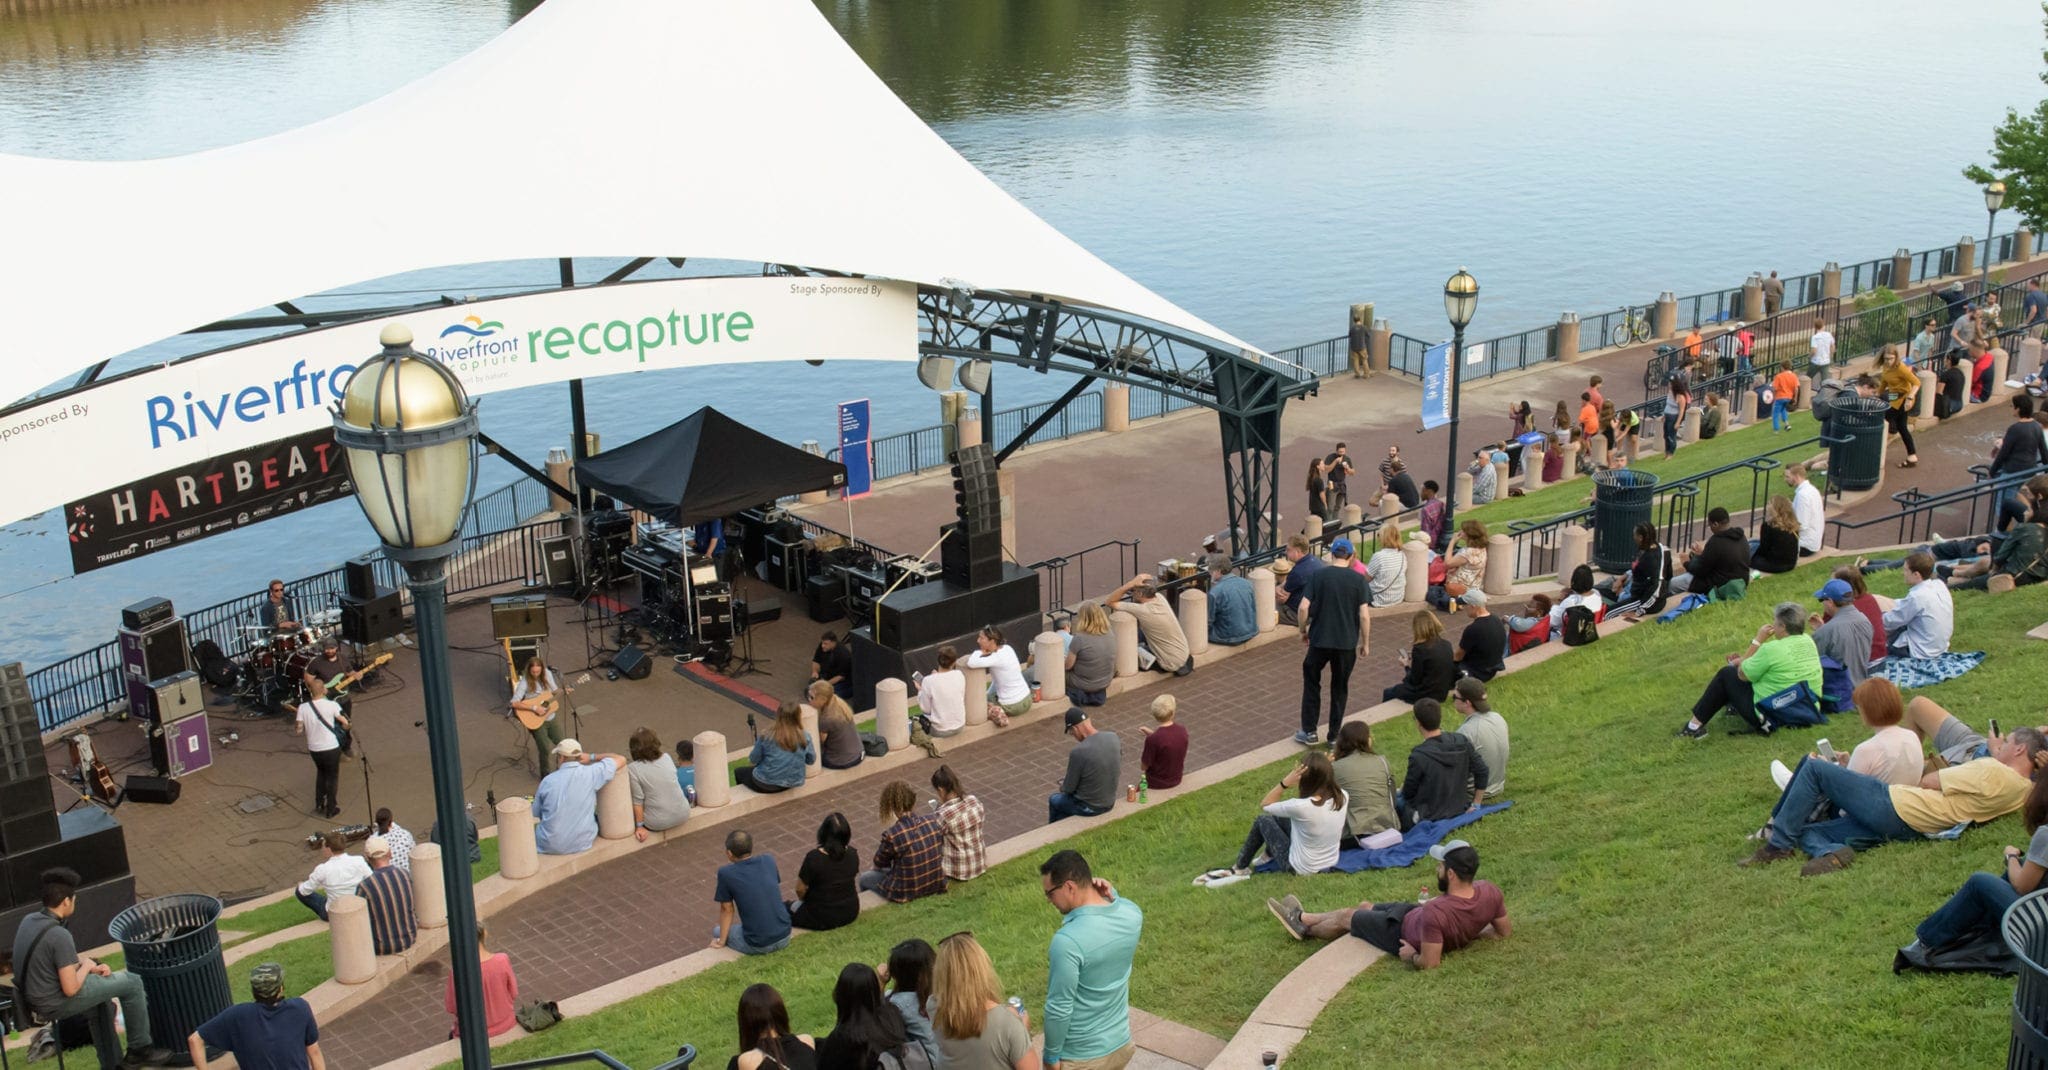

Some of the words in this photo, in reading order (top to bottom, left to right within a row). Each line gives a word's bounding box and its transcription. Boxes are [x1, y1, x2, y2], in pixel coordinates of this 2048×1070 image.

[790, 284, 817, 296] Stage
[820, 284, 868, 296] Sponsored
[871, 285, 882, 297] By
[427, 337, 518, 363] Riverfront
[527, 308, 754, 363] recapture
[0, 408, 68, 442] ponsored
[72, 404, 88, 416] By
[146, 359, 358, 449] Riverfro
[112, 442, 332, 525] HARTBEAT
[97, 548, 133, 562] TRAVELERS
